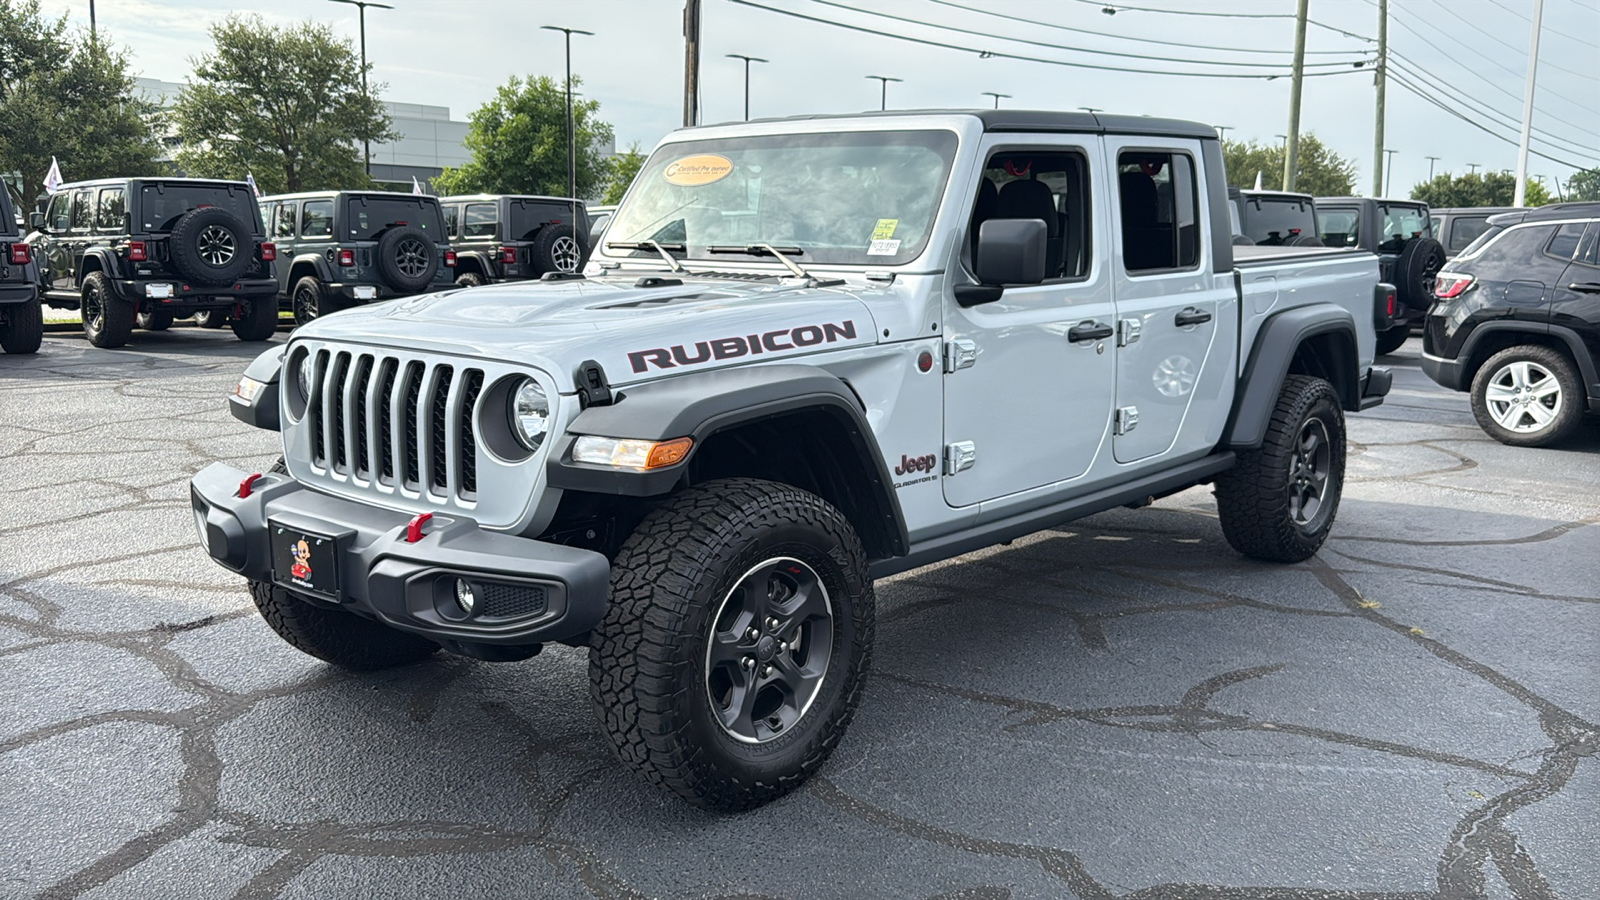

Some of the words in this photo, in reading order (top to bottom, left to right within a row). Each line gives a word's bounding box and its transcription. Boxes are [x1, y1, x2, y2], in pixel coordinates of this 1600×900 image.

[627, 319, 857, 374] RUBICON
[894, 453, 937, 476] Jeep
[893, 476, 931, 489] GLADIATOR
